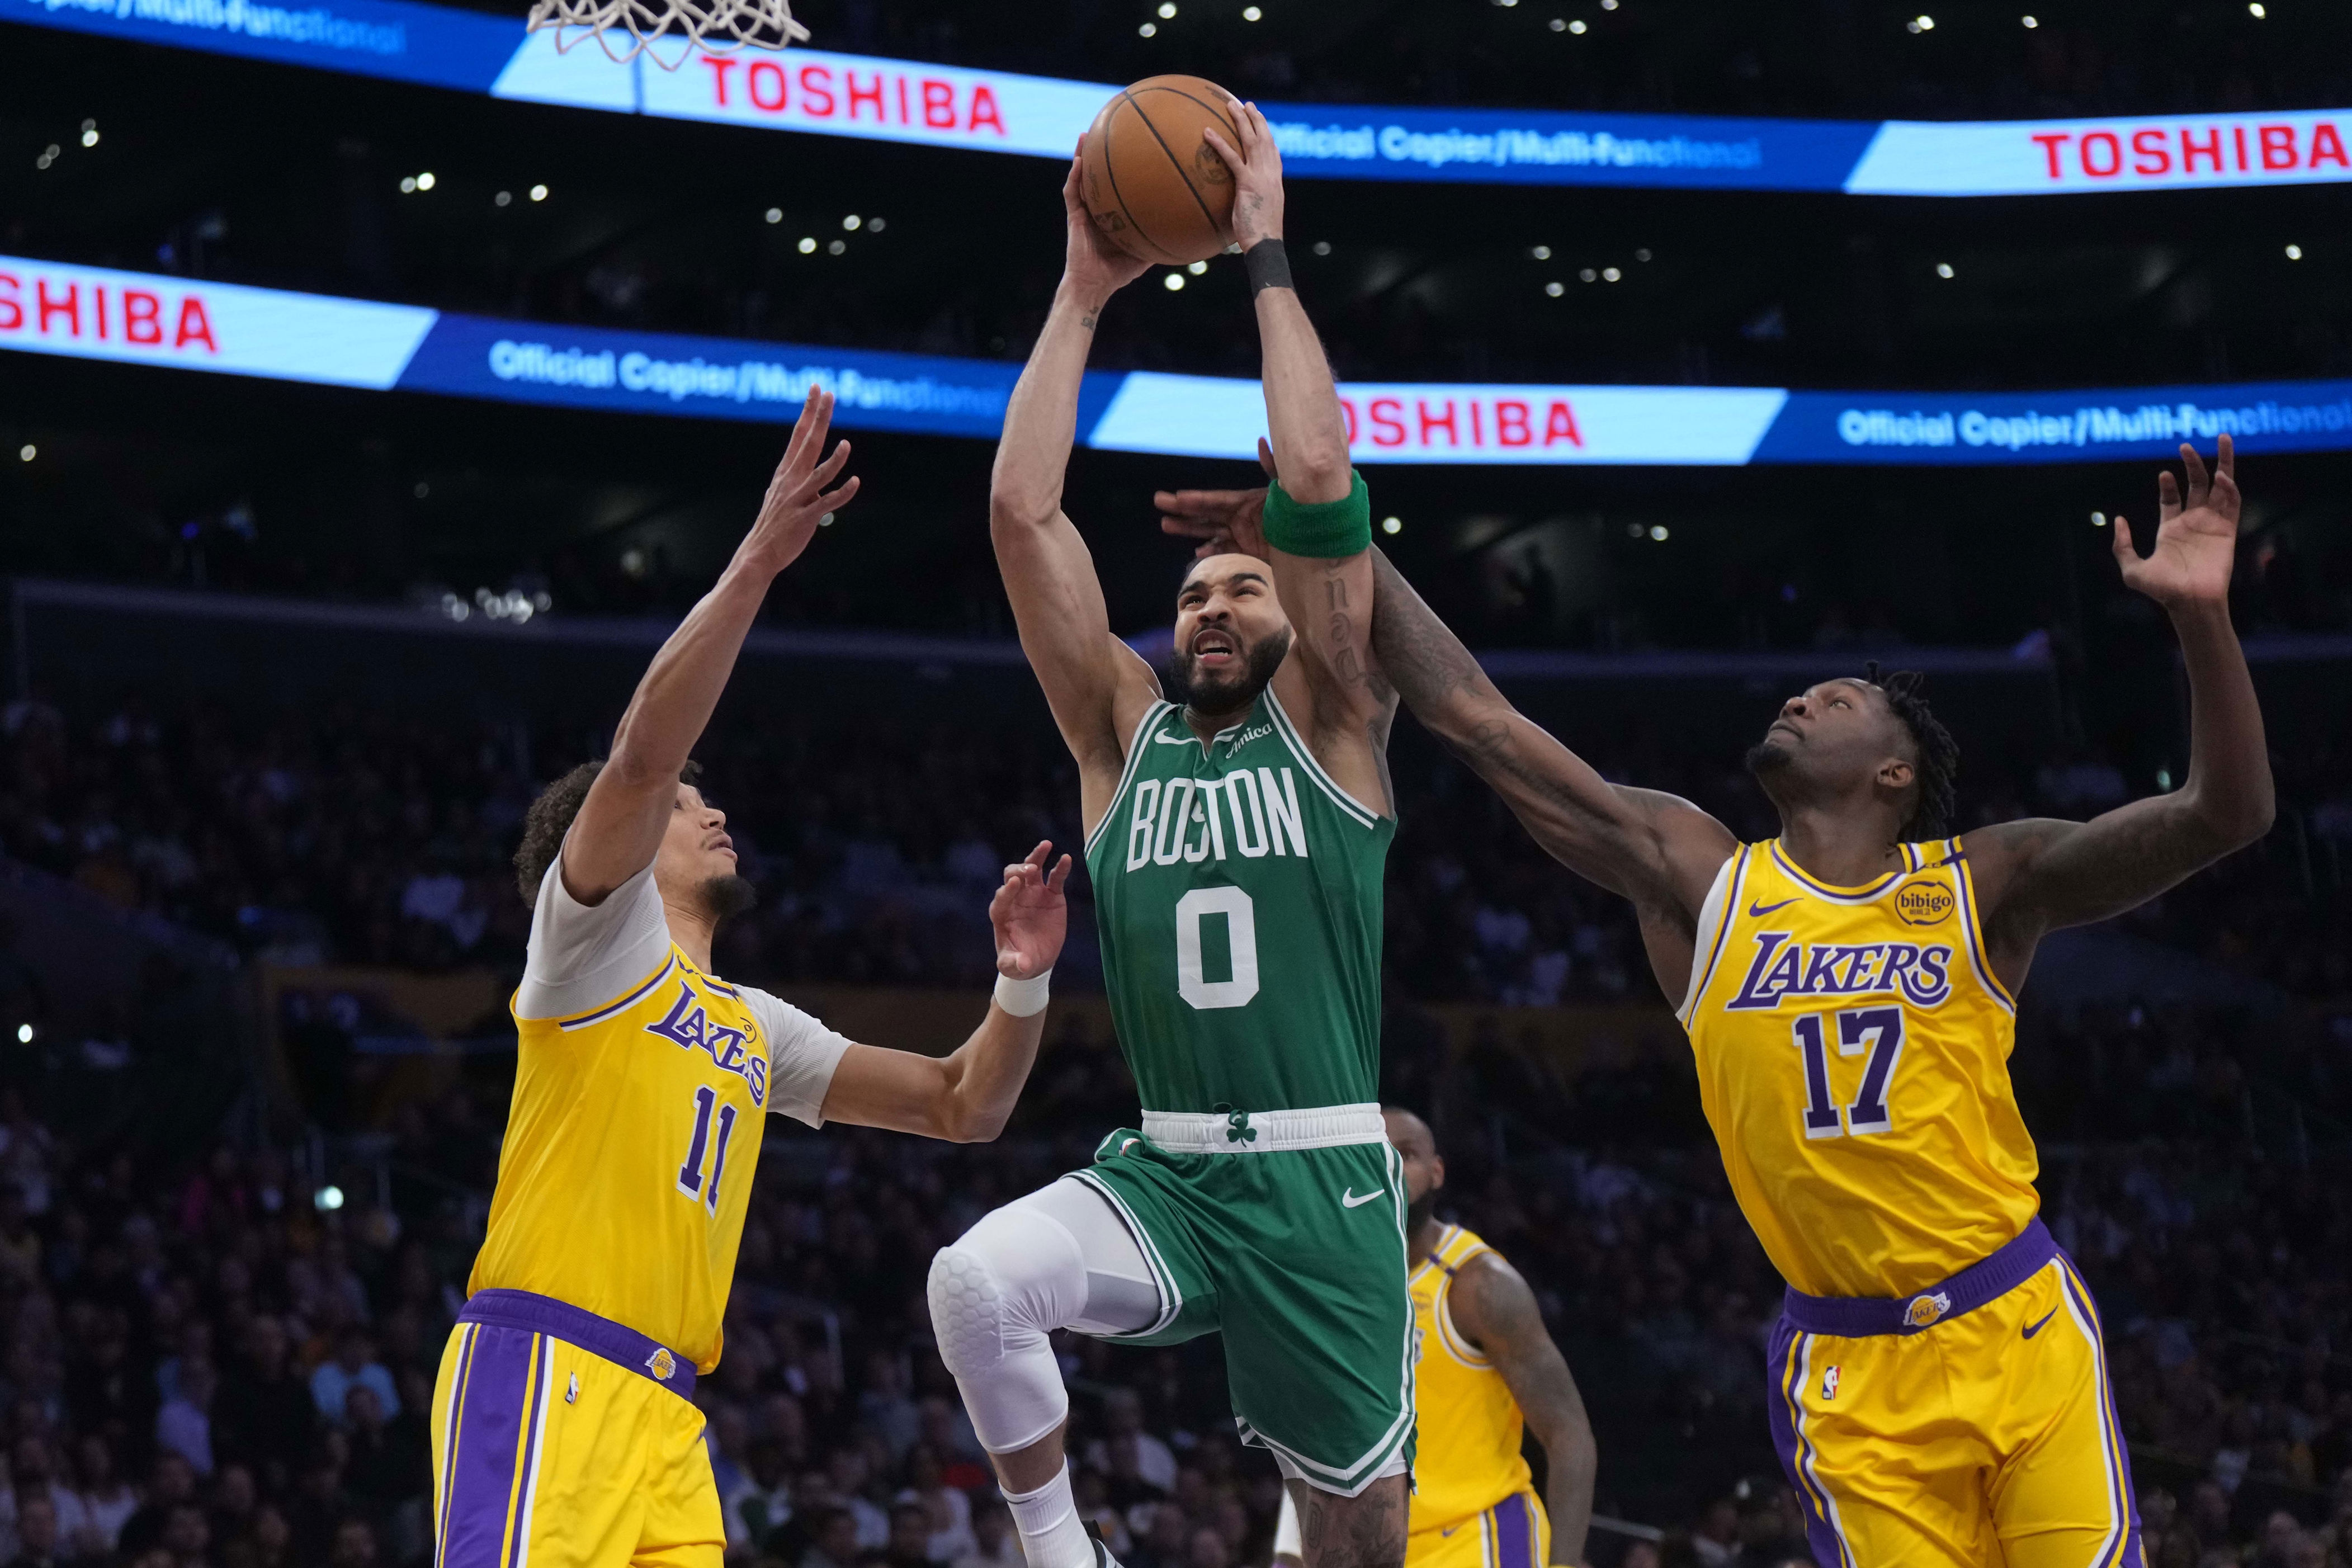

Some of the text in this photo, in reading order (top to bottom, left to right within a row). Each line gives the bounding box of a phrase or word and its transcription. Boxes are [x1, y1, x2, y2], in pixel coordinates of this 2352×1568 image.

[701, 55, 1005, 135] TOSHIBA
[2031, 124, 2349, 178] TOSHIBA
[489, 339, 615, 388] Official
[1837, 409, 1956, 446] Official
[1225, 723, 1272, 759] Amica
[1126, 767, 1309, 873] BOSTON
[1901, 892, 1951, 912] bibigo
[1175, 885, 1259, 1010] 0
[1724, 931, 1954, 1012] LAKERS
[643, 979, 767, 1108] LAKES
[1791, 1003, 1906, 1140] 17
[676, 1083, 738, 1219] 11
